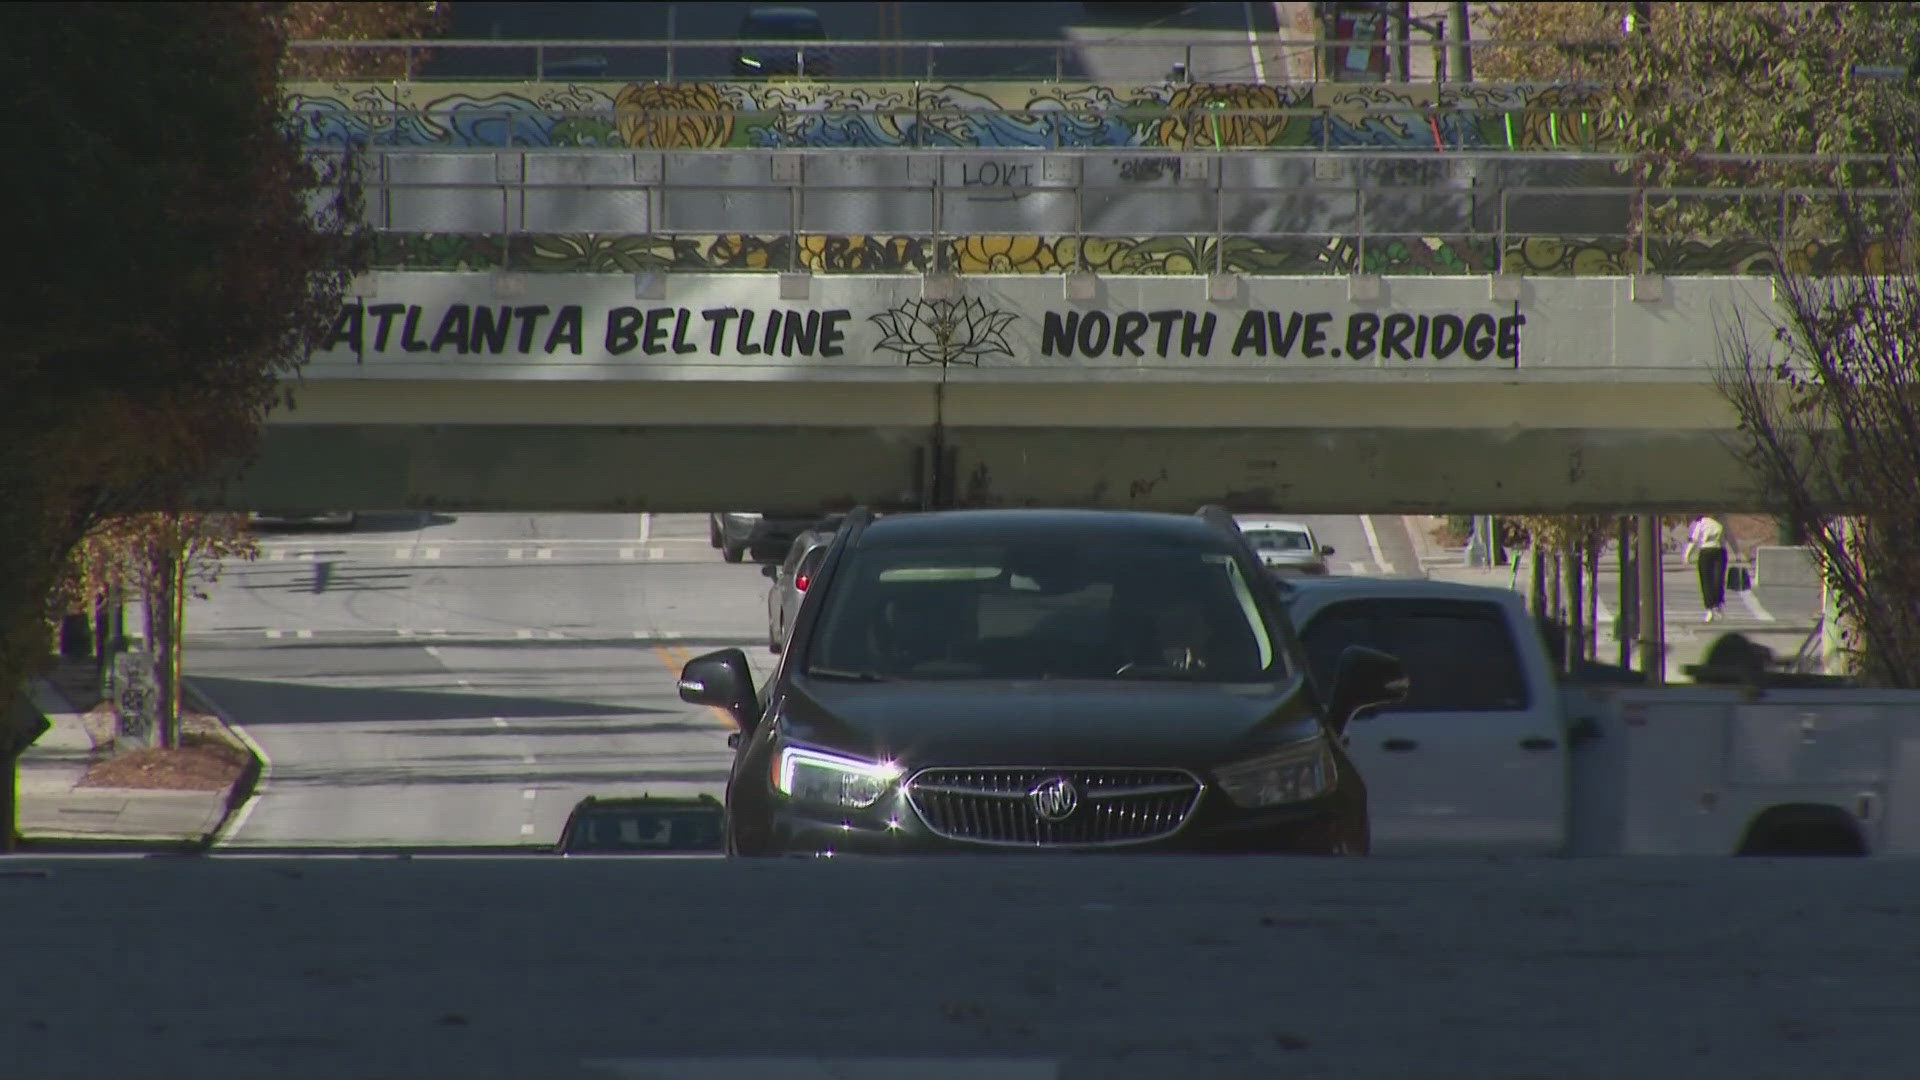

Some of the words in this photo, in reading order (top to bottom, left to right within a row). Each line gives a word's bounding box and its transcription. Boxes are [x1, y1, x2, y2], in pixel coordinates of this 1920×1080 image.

[322, 303, 583, 355] ATLANTA
[604, 308, 852, 356] BELTLINE
[1041, 310, 1217, 359] NORTH
